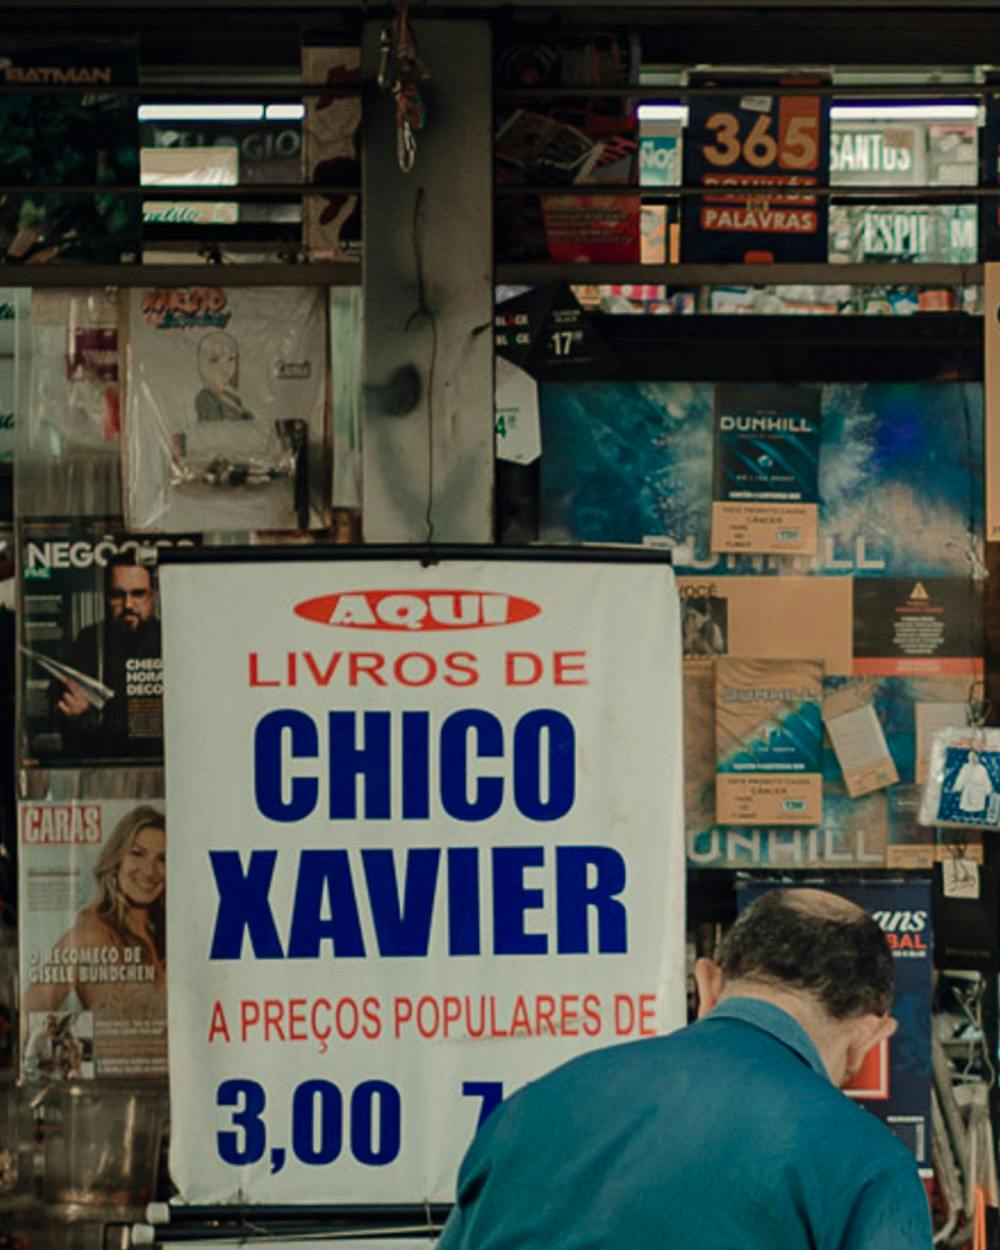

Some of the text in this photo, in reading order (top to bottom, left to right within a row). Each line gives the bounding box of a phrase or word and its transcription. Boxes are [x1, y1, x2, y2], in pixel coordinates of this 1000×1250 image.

[4, 63, 111, 84] BATMAN
[703, 111, 817, 168] 365
[704, 209, 814, 231] PALAVRAS
[719, 416, 813, 432] DUNHILL
[329, 596, 510, 630] AQUI
[248, 651, 588, 687] LIVROS DE
[254, 709, 576, 822] CHICO
[24, 806, 101, 843] CARAS
[208, 845, 629, 961] XAVIER
[124, 946, 142, 964] DE
[28, 965, 74, 985] GISELE
[208, 993, 658, 1054] A PREÇOS POPULARES DE
[217, 1078, 402, 1174] 3,00
